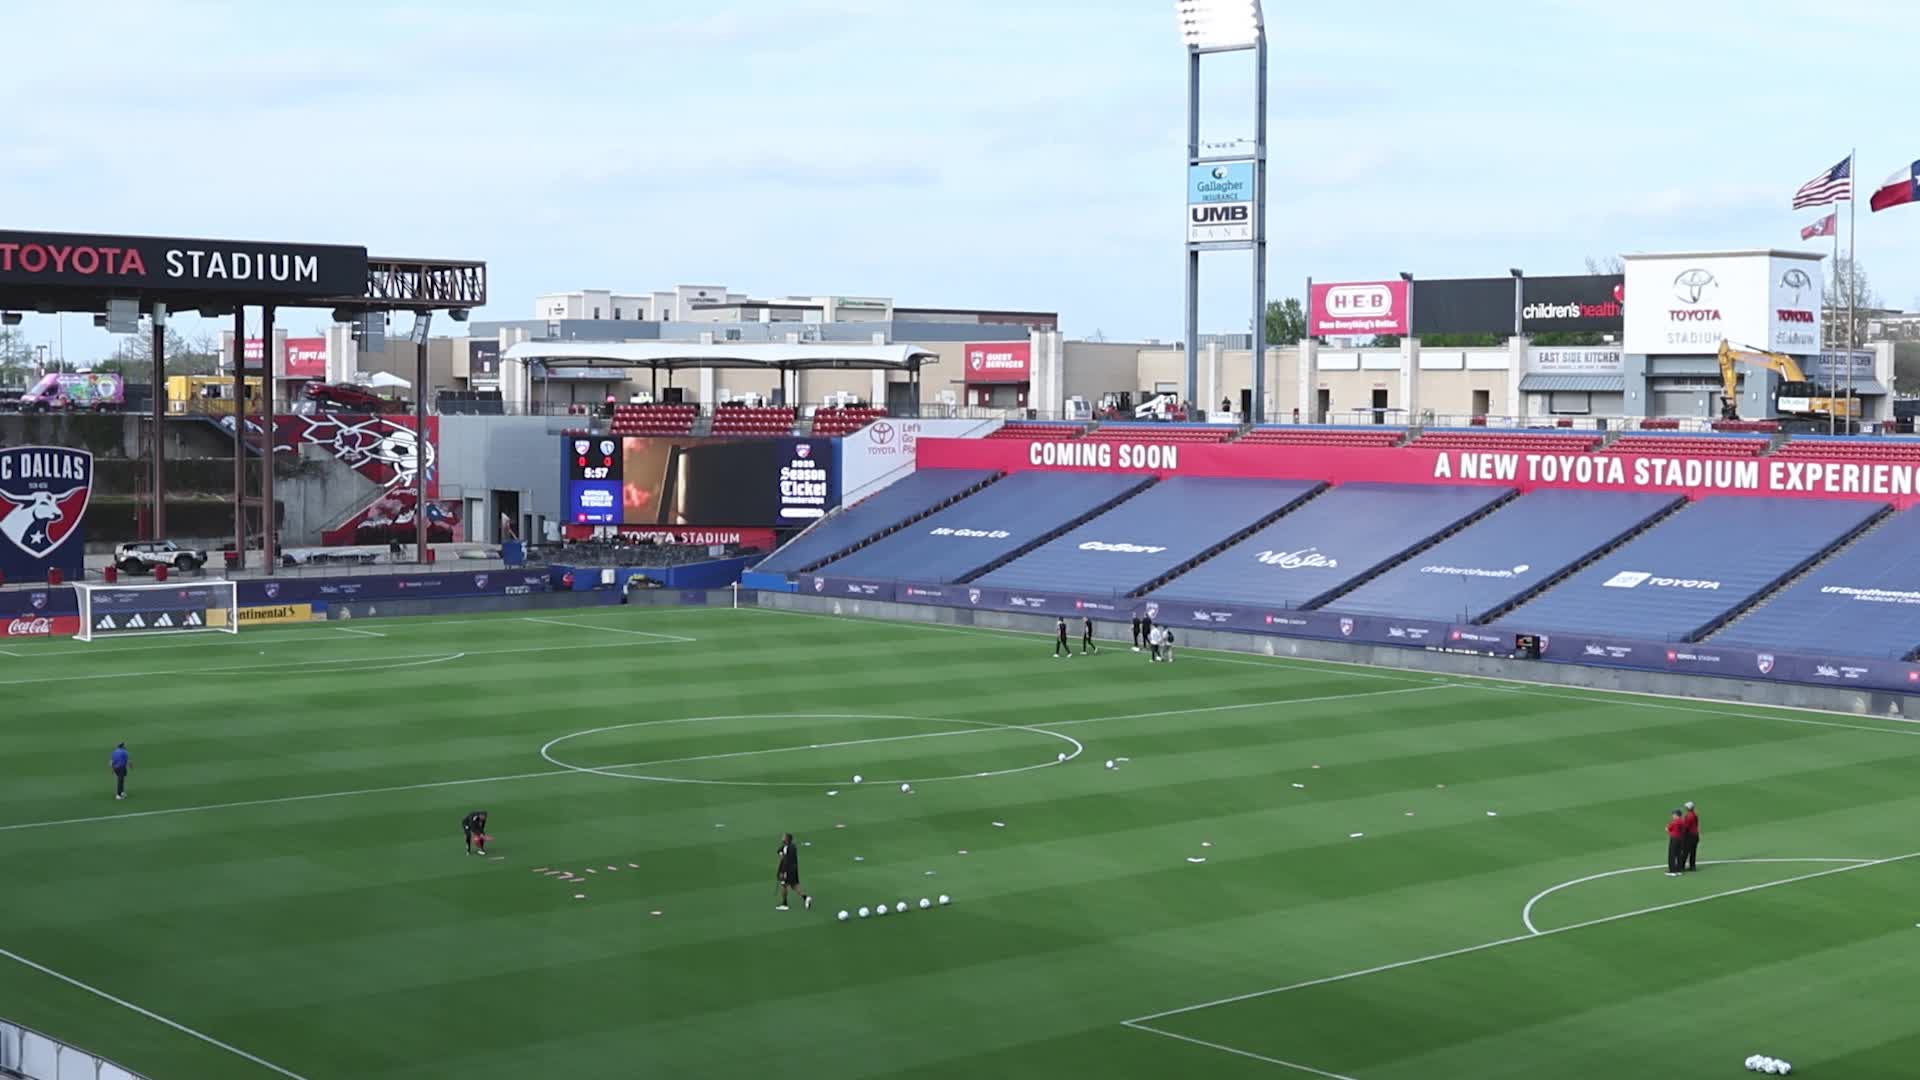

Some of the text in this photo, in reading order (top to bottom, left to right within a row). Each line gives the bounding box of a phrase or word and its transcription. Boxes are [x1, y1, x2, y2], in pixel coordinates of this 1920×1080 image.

[1197, 181, 1243, 192] Gallagher
[1192, 205, 1248, 222] UMB
[0, 243, 318, 282] TOYOTA STADIUM
[1669, 310, 1721, 321] TOYOTA
[1776, 310, 1814, 323] TOYOTA
[1667, 332, 1721, 344] STADIUM
[1539, 352, 1620, 364] EAST SIDE KITCHEN
[868, 447, 896, 455] TOYOTA
[1030, 442, 1177, 469] COMING SOON
[20, 453, 84, 480] DALLAS
[584, 467, 608, 478] 5:57
[780, 466, 826, 480] Season
[1434, 452, 1920, 495] A NEW TOYOTA STADIUM EXPERIEN
[780, 481, 827, 496] Ticket
[681, 532, 739, 543] STADIUM
[1648, 577, 1720, 590] TOYOTA
[227, 606, 286, 624] Cntinental
